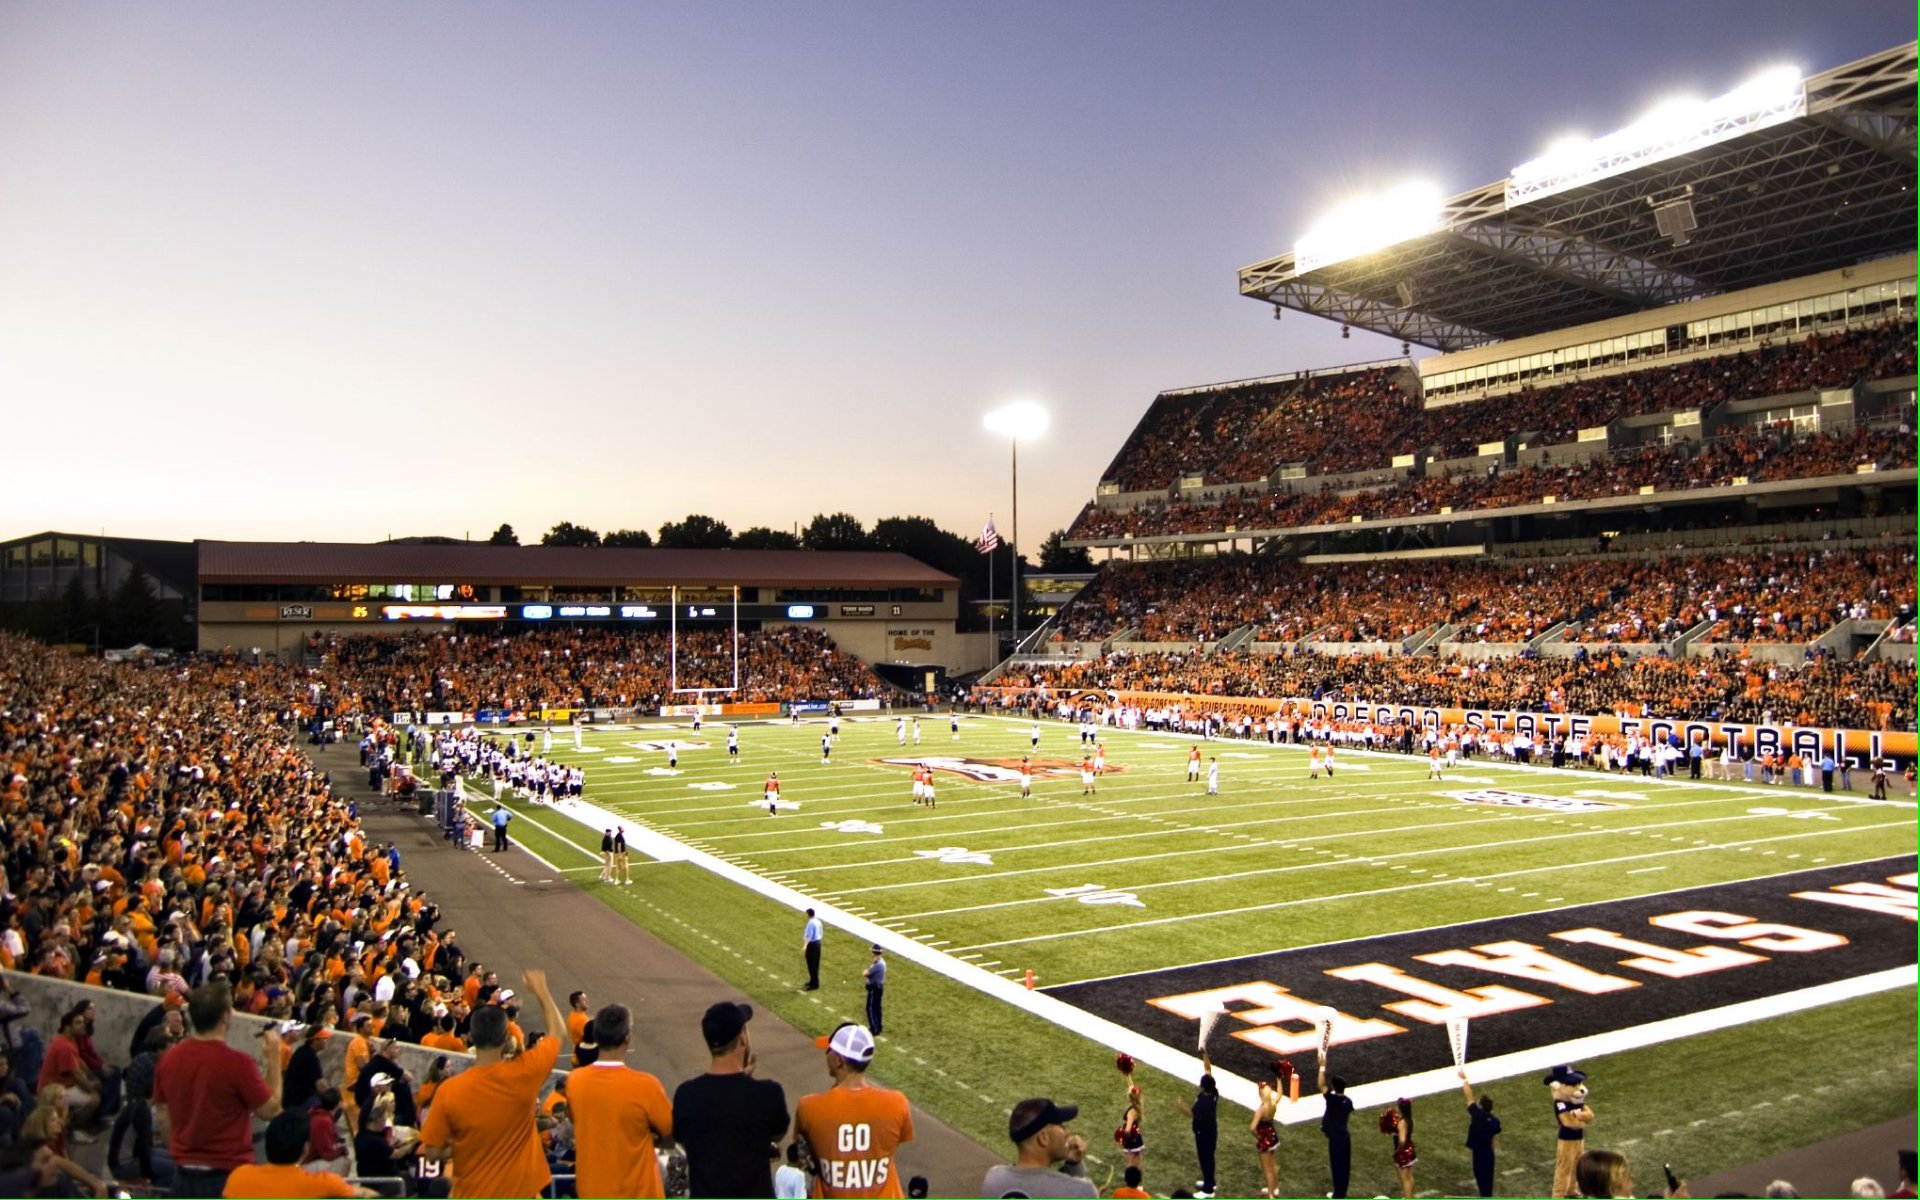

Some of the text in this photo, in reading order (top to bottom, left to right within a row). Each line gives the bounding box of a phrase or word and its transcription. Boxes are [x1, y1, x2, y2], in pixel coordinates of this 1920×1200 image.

[283, 607, 310, 616] RESER
[893, 606, 900, 615] 11
[1464, 710, 1591, 743] STATE
[1043, 883, 1139, 905] 10
[1145, 909, 1850, 1055] STATE
[838, 1123, 871, 1153] GO
[418, 1156, 440, 1178] 19
[819, 1156, 890, 1189] BEAVS
